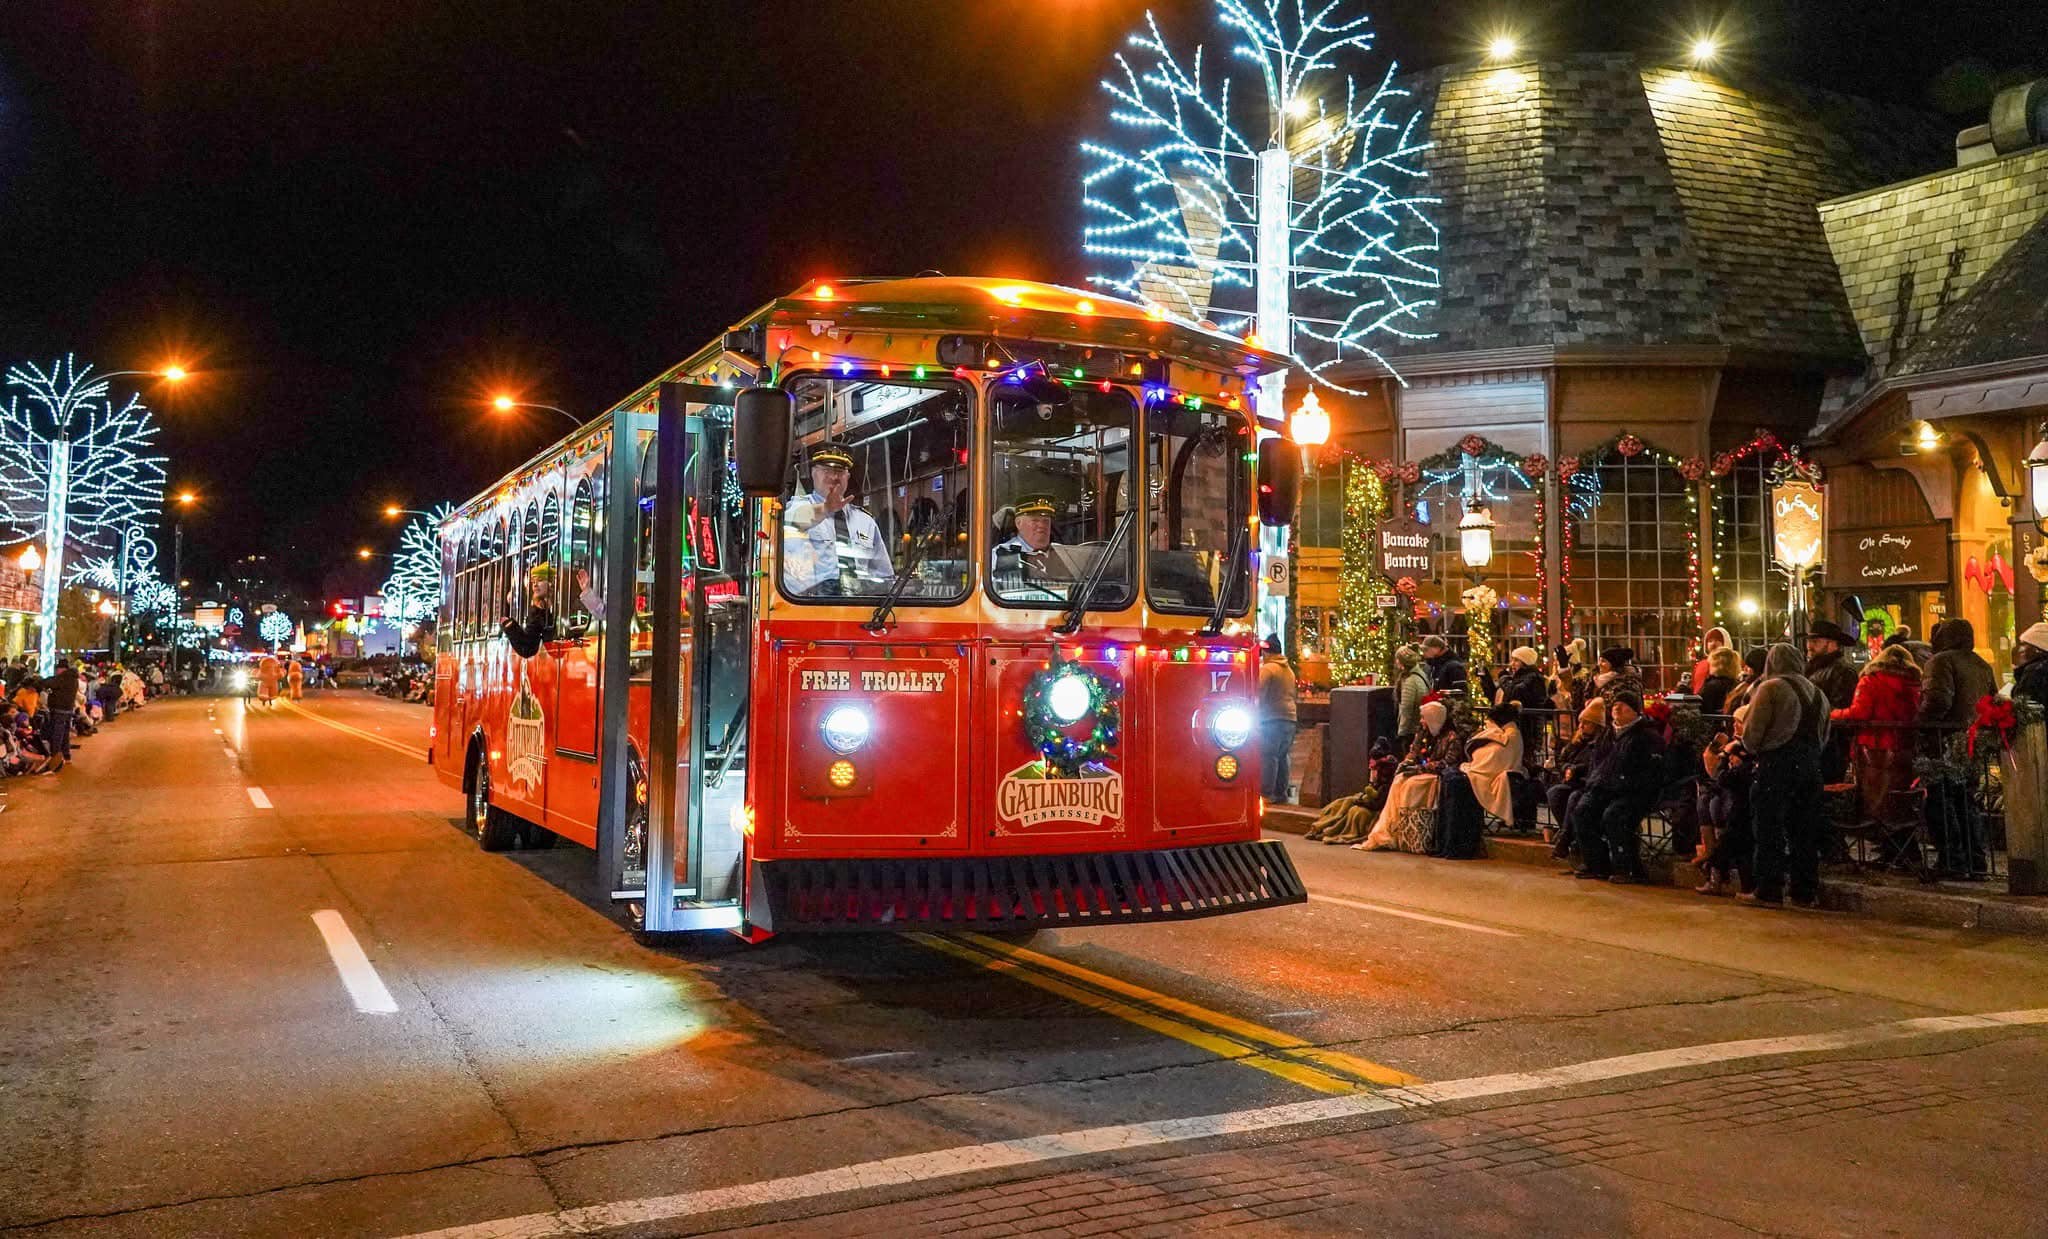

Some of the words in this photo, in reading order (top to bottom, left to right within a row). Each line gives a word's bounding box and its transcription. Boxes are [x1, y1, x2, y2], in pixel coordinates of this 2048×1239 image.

[1382, 531, 1430, 549] Pancake
[1859, 537, 1876, 551] Ole
[1383, 552, 1429, 570] Pantry
[1861, 565, 1888, 578] Candy
[1888, 563, 1918, 577] Kitchen
[801, 670, 850, 691] FREE
[861, 671, 945, 692] TROLLEY
[1211, 671, 1232, 692] 17
[1000, 778, 1119, 818] GATLINBURG
[1024, 809, 1098, 823] TENNESSEE
